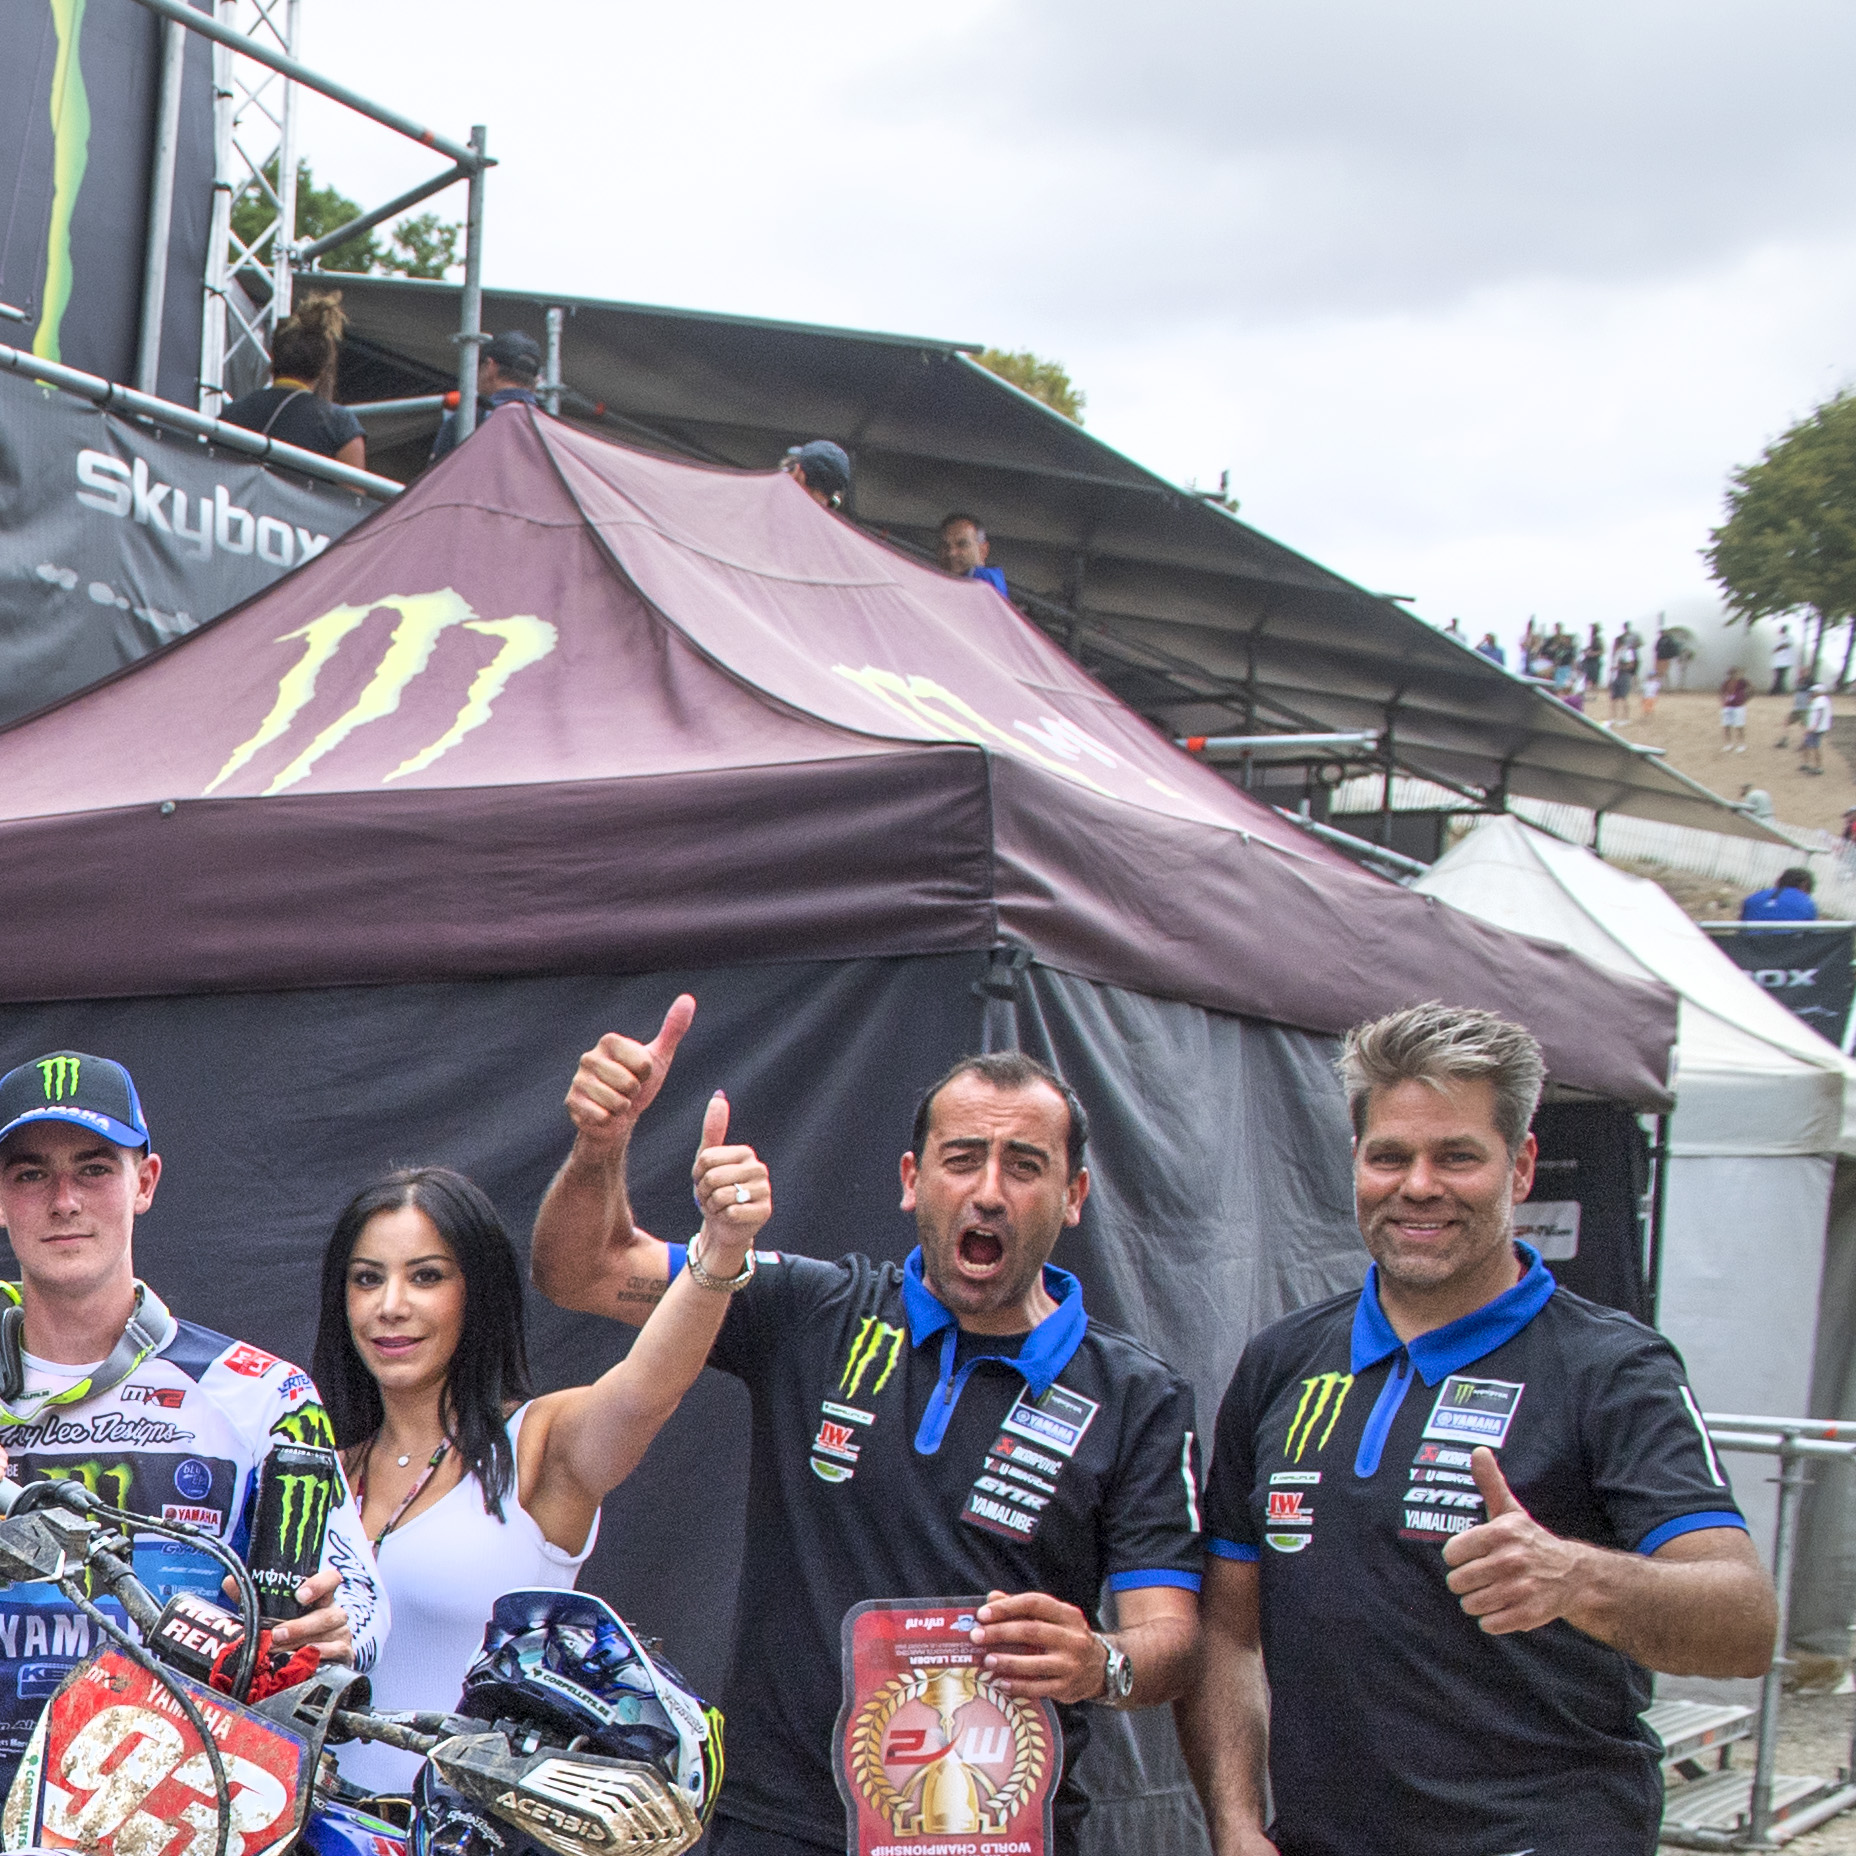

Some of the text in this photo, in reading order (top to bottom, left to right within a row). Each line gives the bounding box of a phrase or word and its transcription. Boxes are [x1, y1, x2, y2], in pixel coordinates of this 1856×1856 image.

[121, 1385, 186, 1408] MX2
[43, 1412, 195, 1447] Lee Designs
[1028, 1414, 1075, 1442] YAMAHA
[1453, 1414, 1501, 1432] YAMAHA
[974, 1476, 1050, 1509] GYTR
[1403, 1488, 1484, 1508] GYTR
[178, 1509, 218, 1524] YAMAHA
[971, 1496, 1036, 1533] YAMALUBE
[910, 1656, 948, 1664] LEADER
[496, 1791, 608, 1841] ACERBIS
[870, 1843, 1031, 1856] WORLD CHAMPIONSHIP
